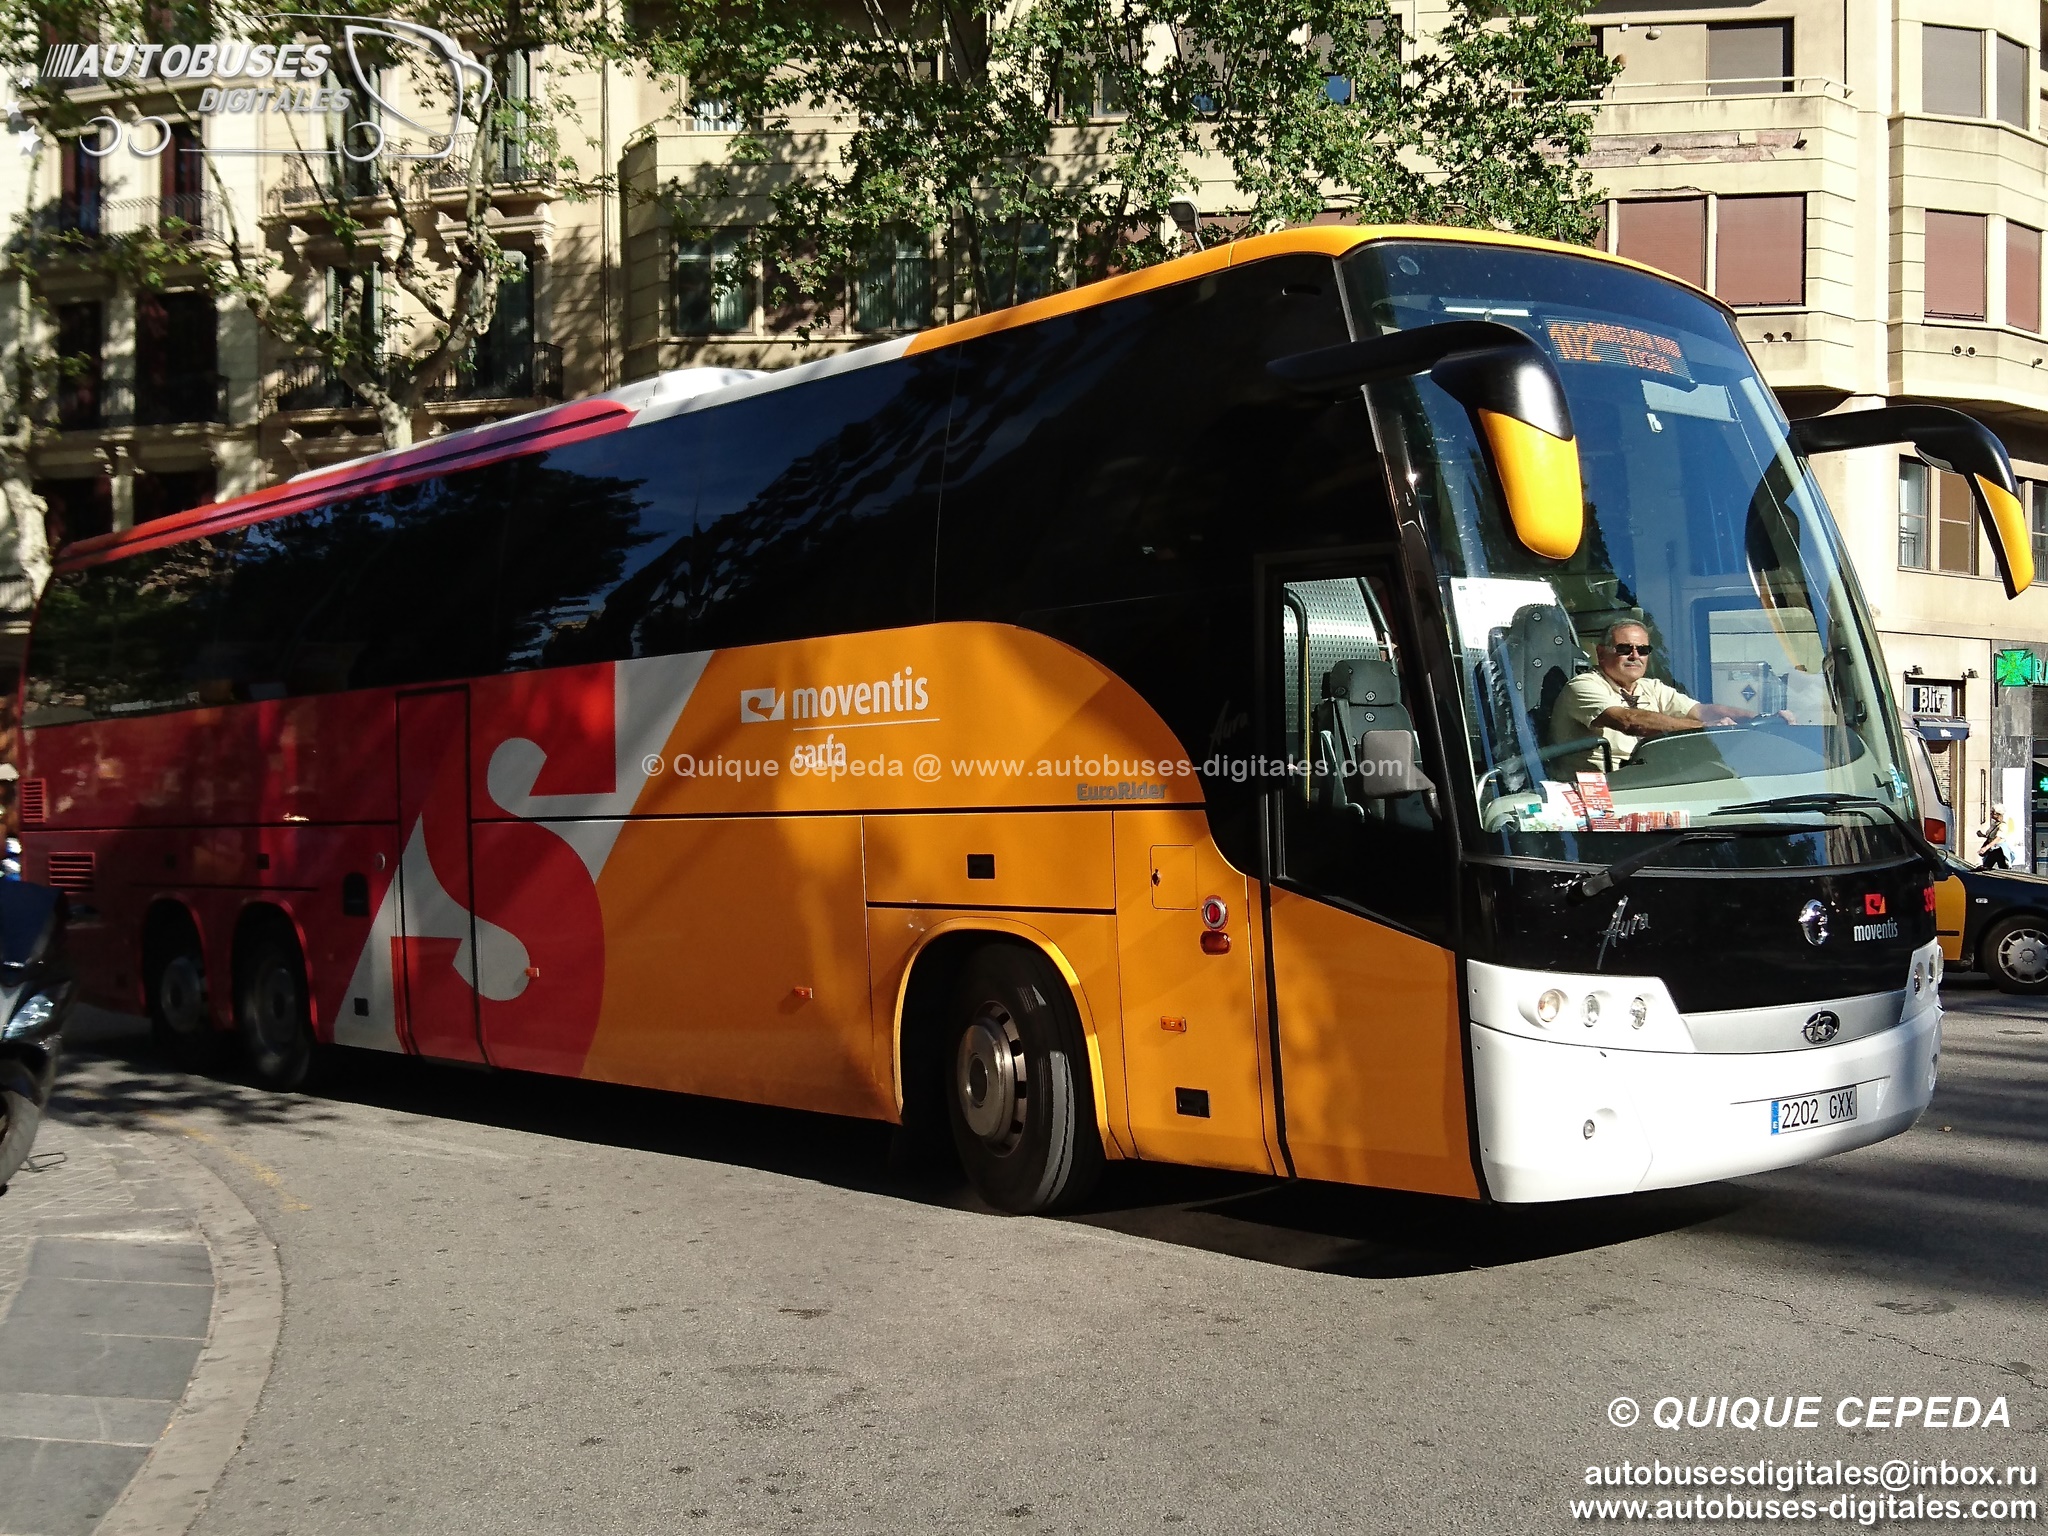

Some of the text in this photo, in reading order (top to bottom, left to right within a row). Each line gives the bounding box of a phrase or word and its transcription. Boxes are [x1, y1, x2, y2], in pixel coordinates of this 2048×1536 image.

[1548, 322, 1601, 362] 102
[793, 667, 929, 719] moventis
[794, 734, 847, 769] sarfa
[1077, 782, 1168, 801] EuroRider
[1853, 917, 1898, 941] moventis
[1782, 1098, 1819, 1129] 2202
[1829, 1091, 1853, 1119] GXX
